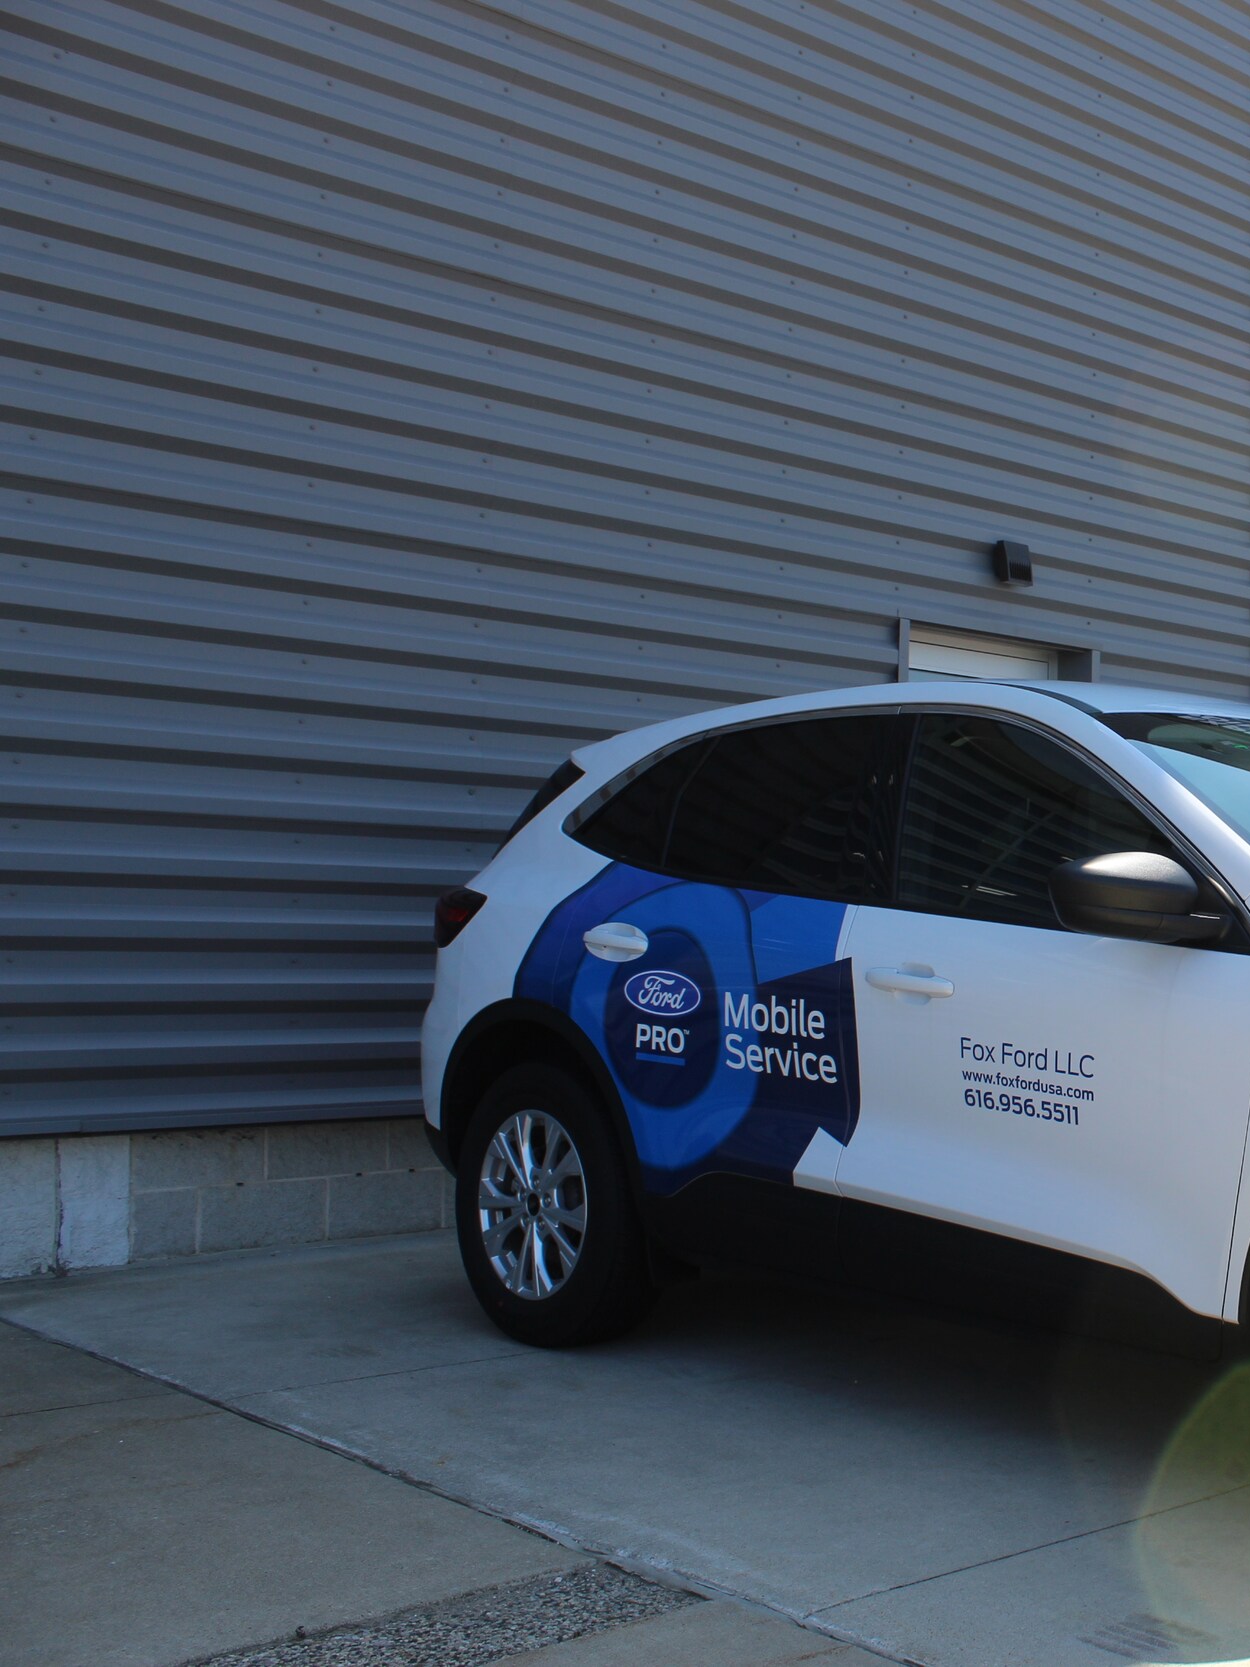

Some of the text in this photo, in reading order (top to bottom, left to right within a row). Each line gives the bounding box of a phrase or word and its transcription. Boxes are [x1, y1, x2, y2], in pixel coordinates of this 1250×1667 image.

[637, 974, 686, 1010] Ford
[723, 991, 826, 1040] Mobile
[725, 1033, 838, 1084] Service
[960, 1037, 1095, 1078] Fox Ford LLC
[961, 1070, 1095, 1101] www.foxfordusa.com
[964, 1088, 1079, 1125] 616.956.5511
